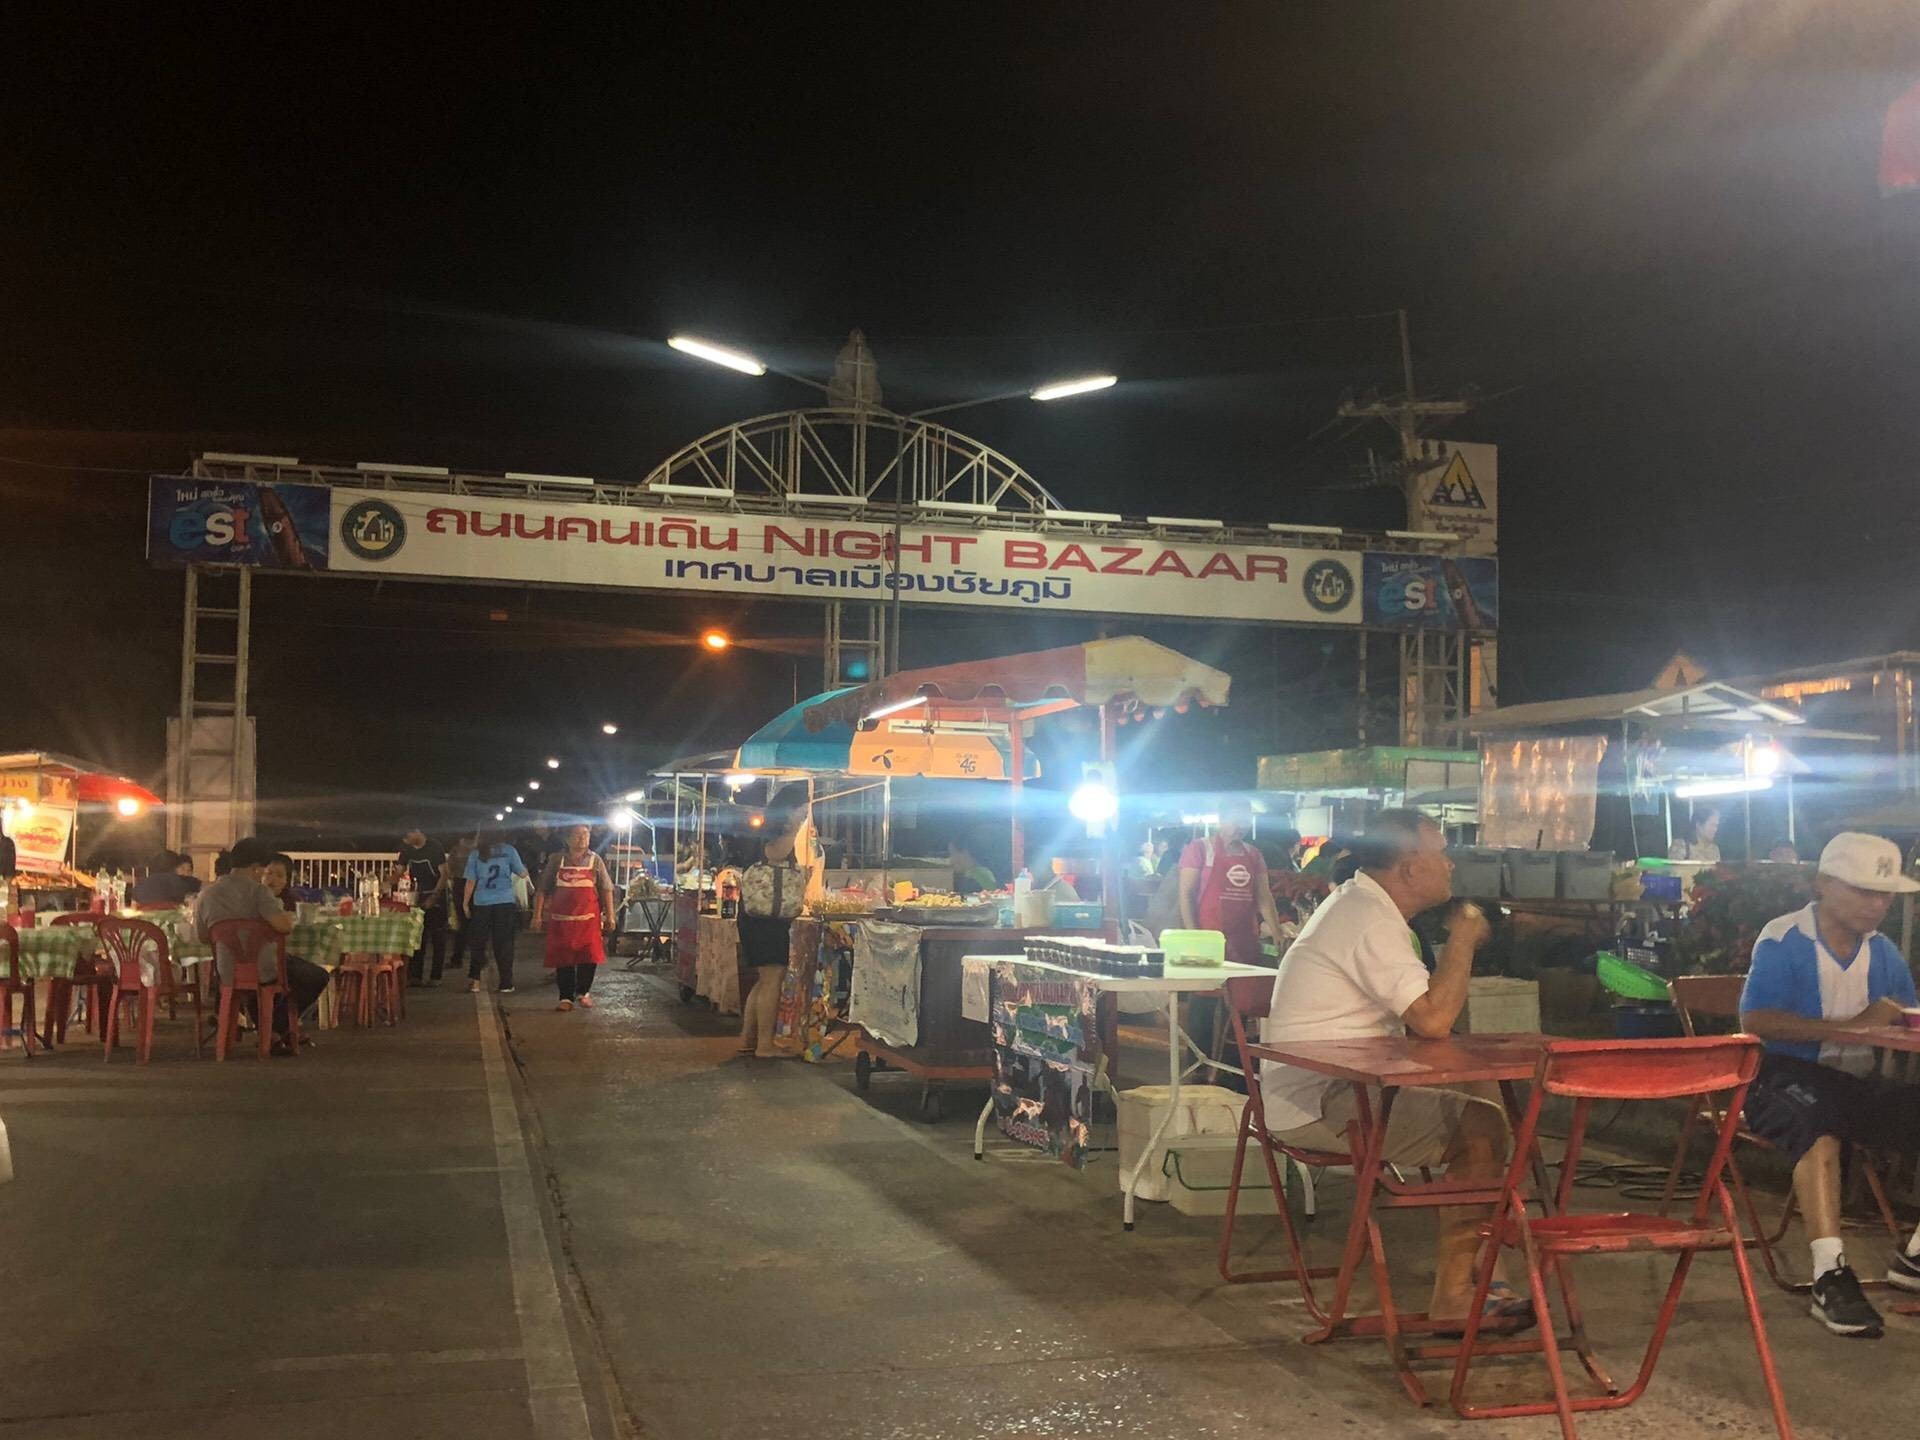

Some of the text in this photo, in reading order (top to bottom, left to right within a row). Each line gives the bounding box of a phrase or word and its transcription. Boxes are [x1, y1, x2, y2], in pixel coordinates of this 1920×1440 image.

[169, 508, 251, 550] est
[426, 508, 1288, 582] ถนนคนเดิน NIGHT BAZAAR
[665, 558, 1072, 605] เทศบาลเมืองชัยภูมิ
[1377, 577, 1439, 615] est
[960, 758, 977, 774] 4G
[485, 864, 501, 889] 2
